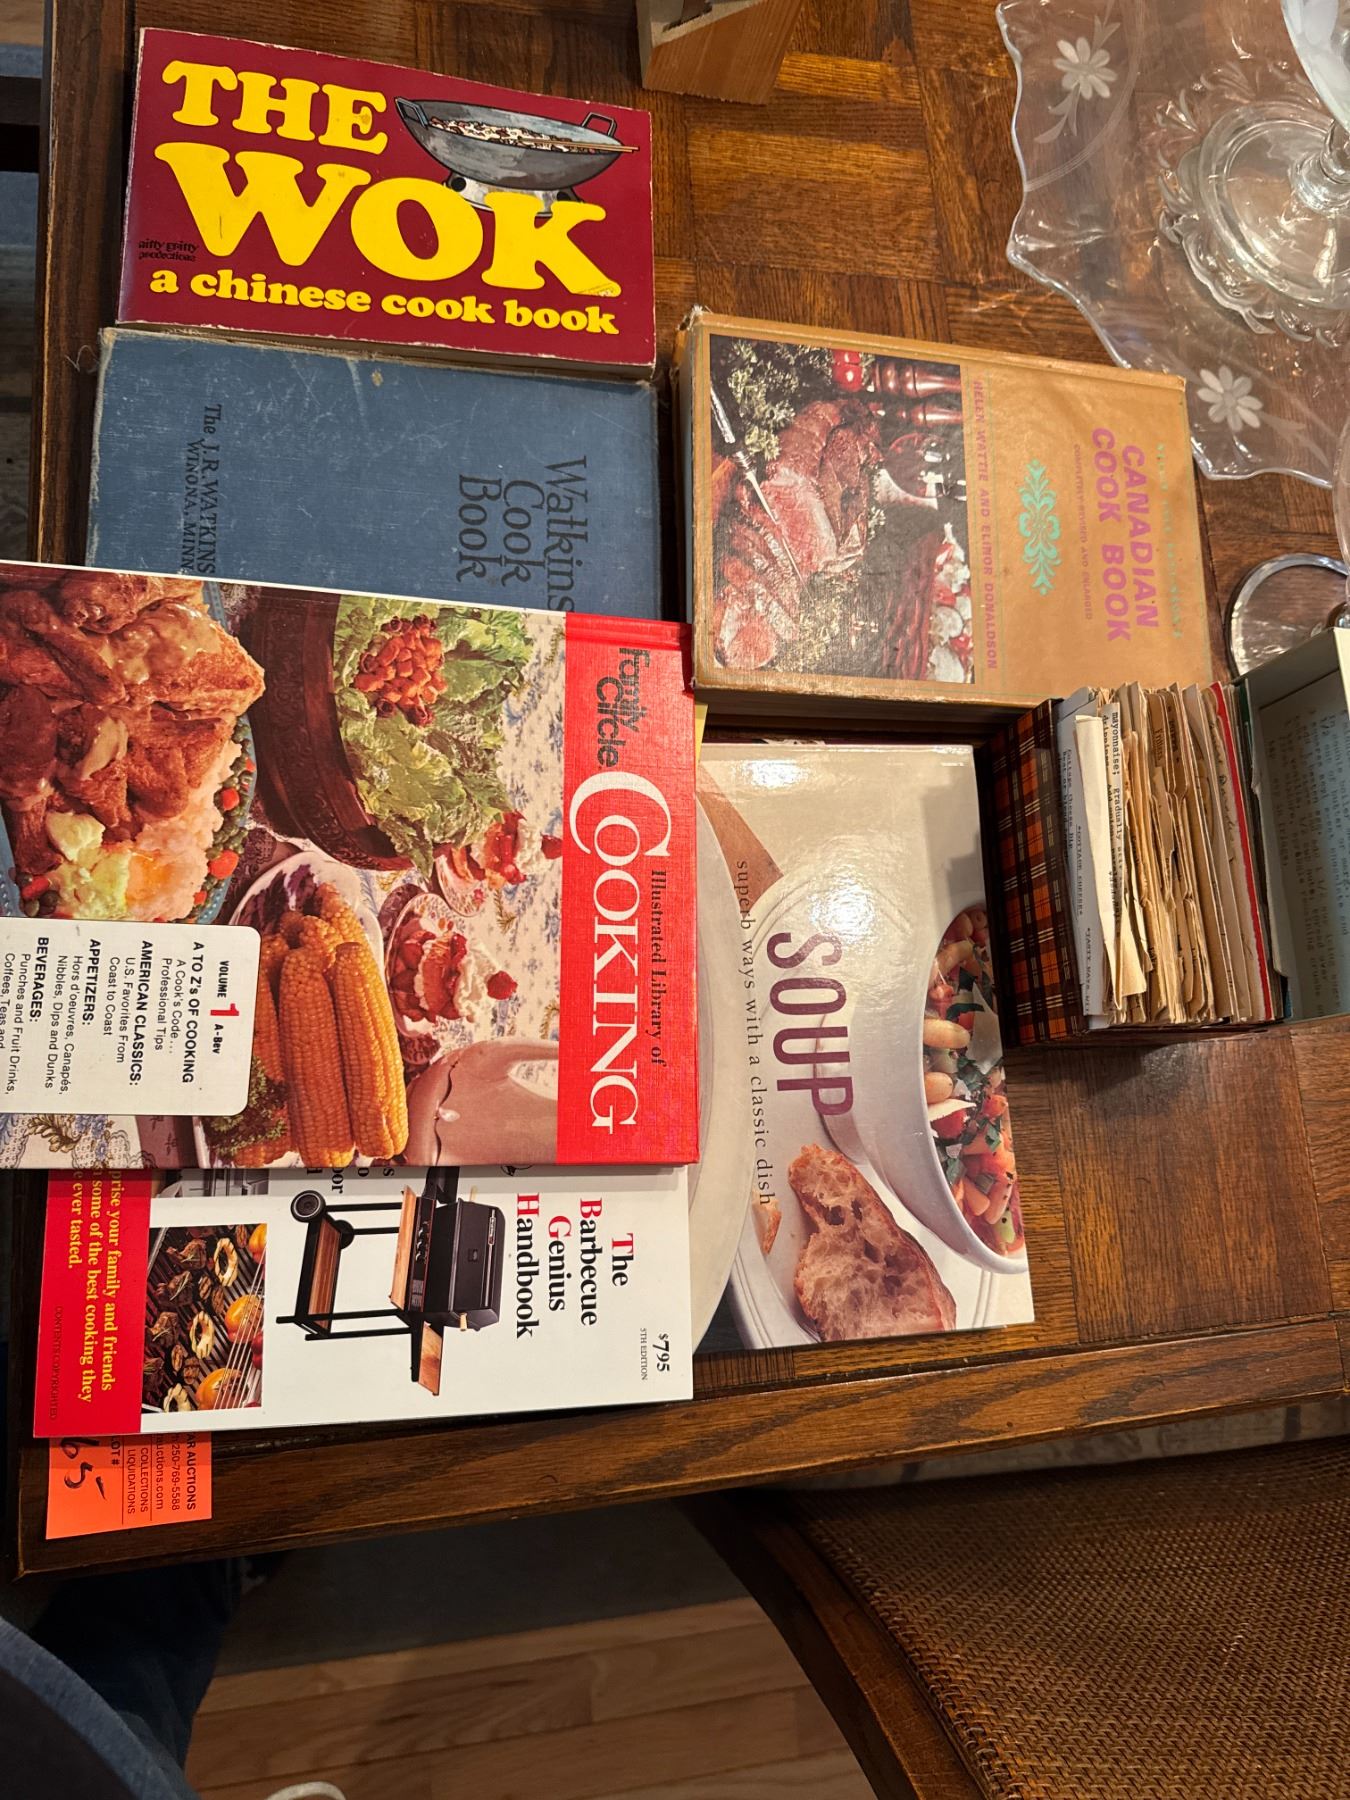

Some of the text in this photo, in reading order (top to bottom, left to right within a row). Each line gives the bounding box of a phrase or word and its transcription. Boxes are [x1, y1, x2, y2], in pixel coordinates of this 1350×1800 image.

[161, 60, 389, 155] THE
[154, 142, 622, 297] WOK
[150, 270, 619, 334] a chinese cook book
[204, 404, 222, 434] The
[197, 480, 218, 574] WATKINS
[456, 474, 502, 583] Book
[501, 480, 546, 587] Cook
[544, 455, 588, 612] Watkins
[973, 381, 997, 668] HELEN WATTIE AND ELINOR DONALDSON
[1080, 547, 1089, 567] AND
[1091, 428, 1130, 642] COOK BOOK
[1122, 445, 1159, 628] CANADIAN
[1082, 572, 1093, 620] ENLARGED
[619, 648, 650, 734] Family
[1111, 712, 1120, 776] mayonnaise;
[1113, 788, 1123, 840] gradually
[1, 953, 15, 997] Coffees,
[30, 937, 49, 1022] BEVERAGES:
[82, 939, 101, 1026] APPETIZERS:
[176, 960, 186, 968] A
[217, 960, 229, 998] VOLUME
[569, 771, 672, 1135] COOKING
[645, 869, 666, 1068] Illustrated Library of
[0, 1001, 10, 1025] Teas
[103, 956, 120, 1036] Coast to Coast
[116, 957, 134, 1064] U.S. Favorites From
[130, 940, 152, 1086] AMERICAN CLASSICS:
[154, 958, 171, 1050] Professional Tips
[172, 970, 186, 1007] Cook's
[182, 942, 204, 1083] A TO Z's OF COOKING
[210, 1003, 240, 1016] 1
[6, 954, 31, 1095] Punches and Fruit Drinks,
[45, 955, 68, 1089] Nibbles, Dips and Dunks
[59, 955, 83, 1095] Hors d'oeuvres, Canapés,
[734, 860, 776, 1206] superb ways with a classic dish
[766, 932, 854, 1116] SOUP
[71, 1182, 83, 1216] ever
[89, 1222, 103, 1238] of
[90, 1180, 102, 1218] some
[106, 1210, 121, 1246] your
[68, 1219, 82, 1269] tasted.
[88, 1241, 102, 1266] the
[102, 1250, 122, 1298] family
[516, 1192, 540, 1339] Handbook
[548, 1216, 572, 1312] Genius
[580, 1198, 602, 1326] Barbecue
[612, 1232, 634, 1287] The
[86, 1270, 102, 1301] best
[104, 1302, 118, 1331] and
[50, 1306, 63, 1421] CONTENTS COPYRIGHTED
[79, 1304, 98, 1365] cooking
[101, 1336, 118, 1391] friends
[640, 1345, 648, 1381] EDITION
[78, 1370, 96, 1403] they
[127, 1449, 136, 1514] LIQUIDATIONS
[140, 1448, 149, 1513] COLLECTIONS
[171, 1444, 180, 1511] 250-769-5588
[186, 1451, 196, 1511] AUCTIONS
